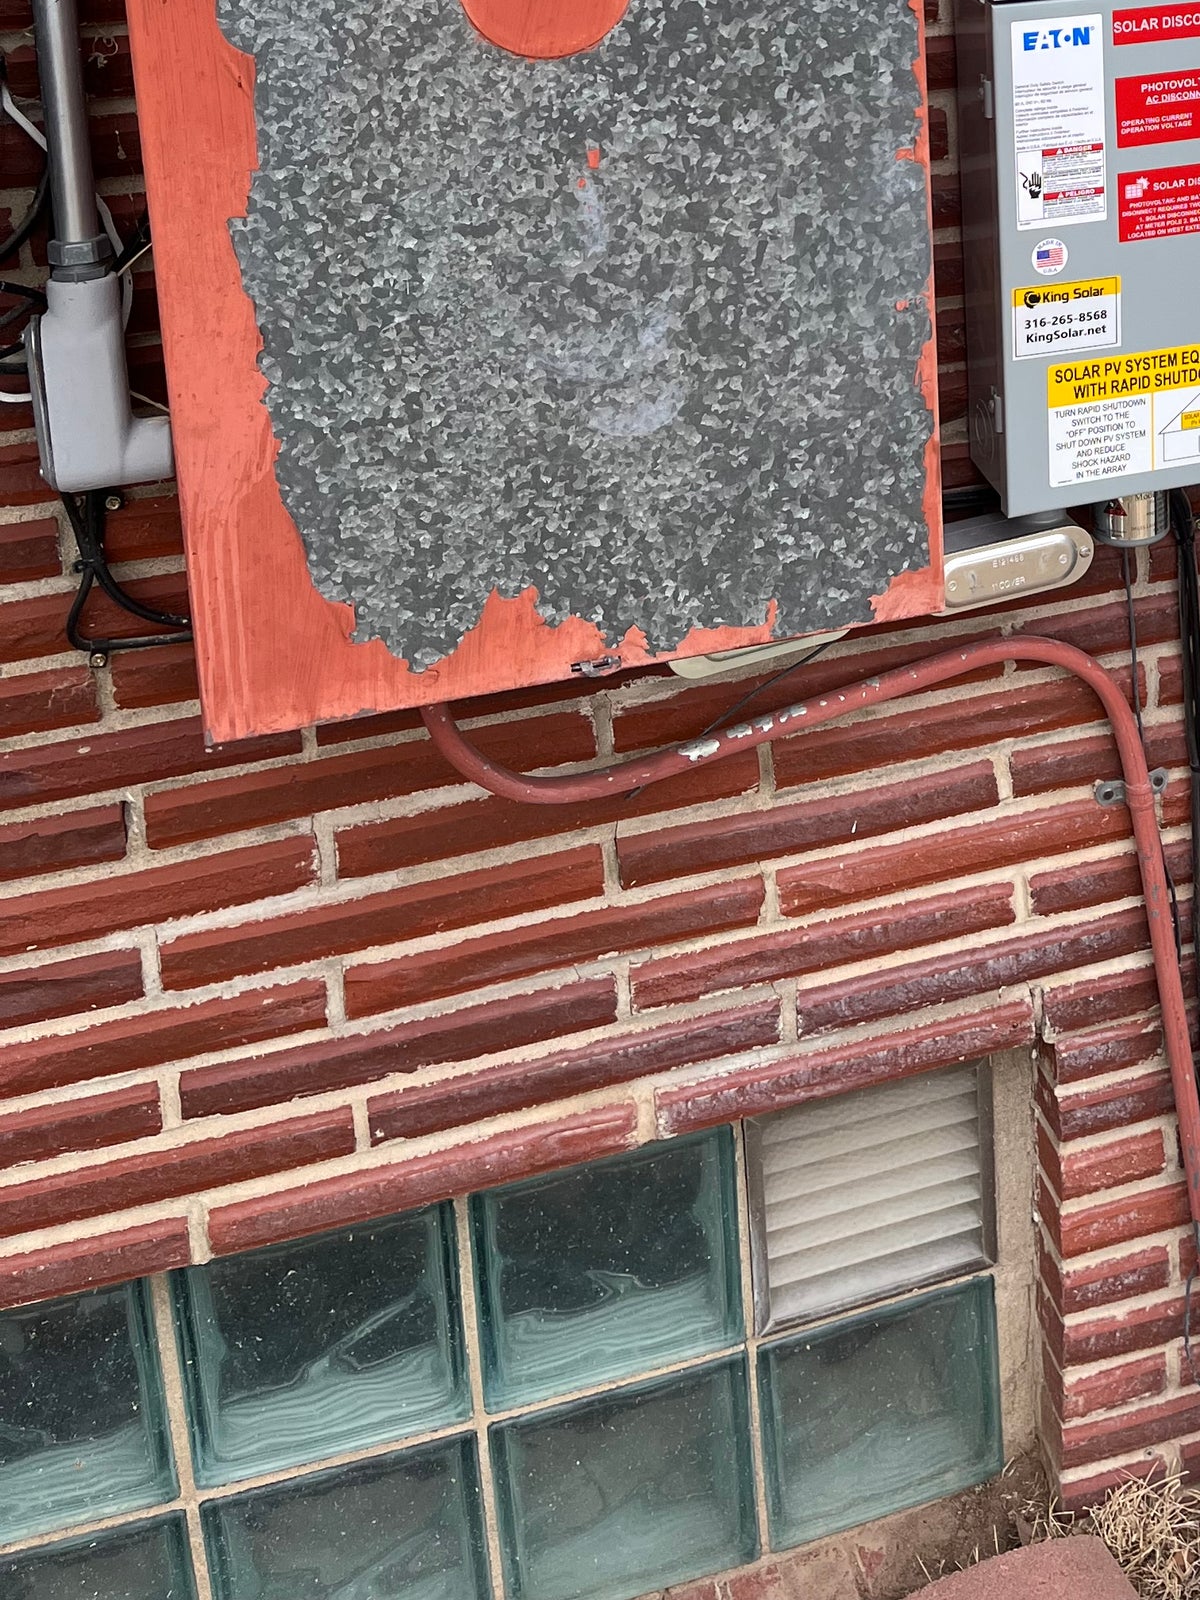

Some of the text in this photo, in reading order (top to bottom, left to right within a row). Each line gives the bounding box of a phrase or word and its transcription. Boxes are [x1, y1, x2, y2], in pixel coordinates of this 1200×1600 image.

[1113, 18, 1159, 34] SOLAR
[1145, 95, 1160, 105] AC
[1120, 119, 1192, 135] OPERATION VOLTAGE
[1121, 112, 1193, 127] OPERATING CURRENT
[1063, 144, 1092, 153] DANGER
[1065, 188, 1095, 197] PELIGRO
[1153, 179, 1185, 191] SOLAR
[1176, 195, 1190, 203] AND
[1127, 230, 1156, 239] LOCATED
[1042, 286, 1105, 303] King Solar
[1025, 309, 1108, 329] 316-265-8568
[1026, 324, 1107, 344] KingSolar.net
[1055, 364, 1101, 384] SOLAR
[1104, 361, 1122, 376] PV
[1125, 353, 1178, 374] SYSTEM
[1073, 381, 1107, 399] WITH
[1111, 376, 1151, 394] RAPID
[1055, 398, 1146, 419] TURN RAPID SHUTDOWN
[1071, 411, 1130, 427] SWITCH TO THE
[1066, 420, 1136, 438] "OFF" POSITION TO
[1055, 429, 1146, 451] SHUT DOWN PV SYSTEM
[1076, 443, 1126, 458] AND REDUCE
[1071, 452, 1131, 470] SHOCK HAZARD
[1076, 464, 1127, 479] IN THE ARRAY
[999, 576, 1026, 590] COVER
